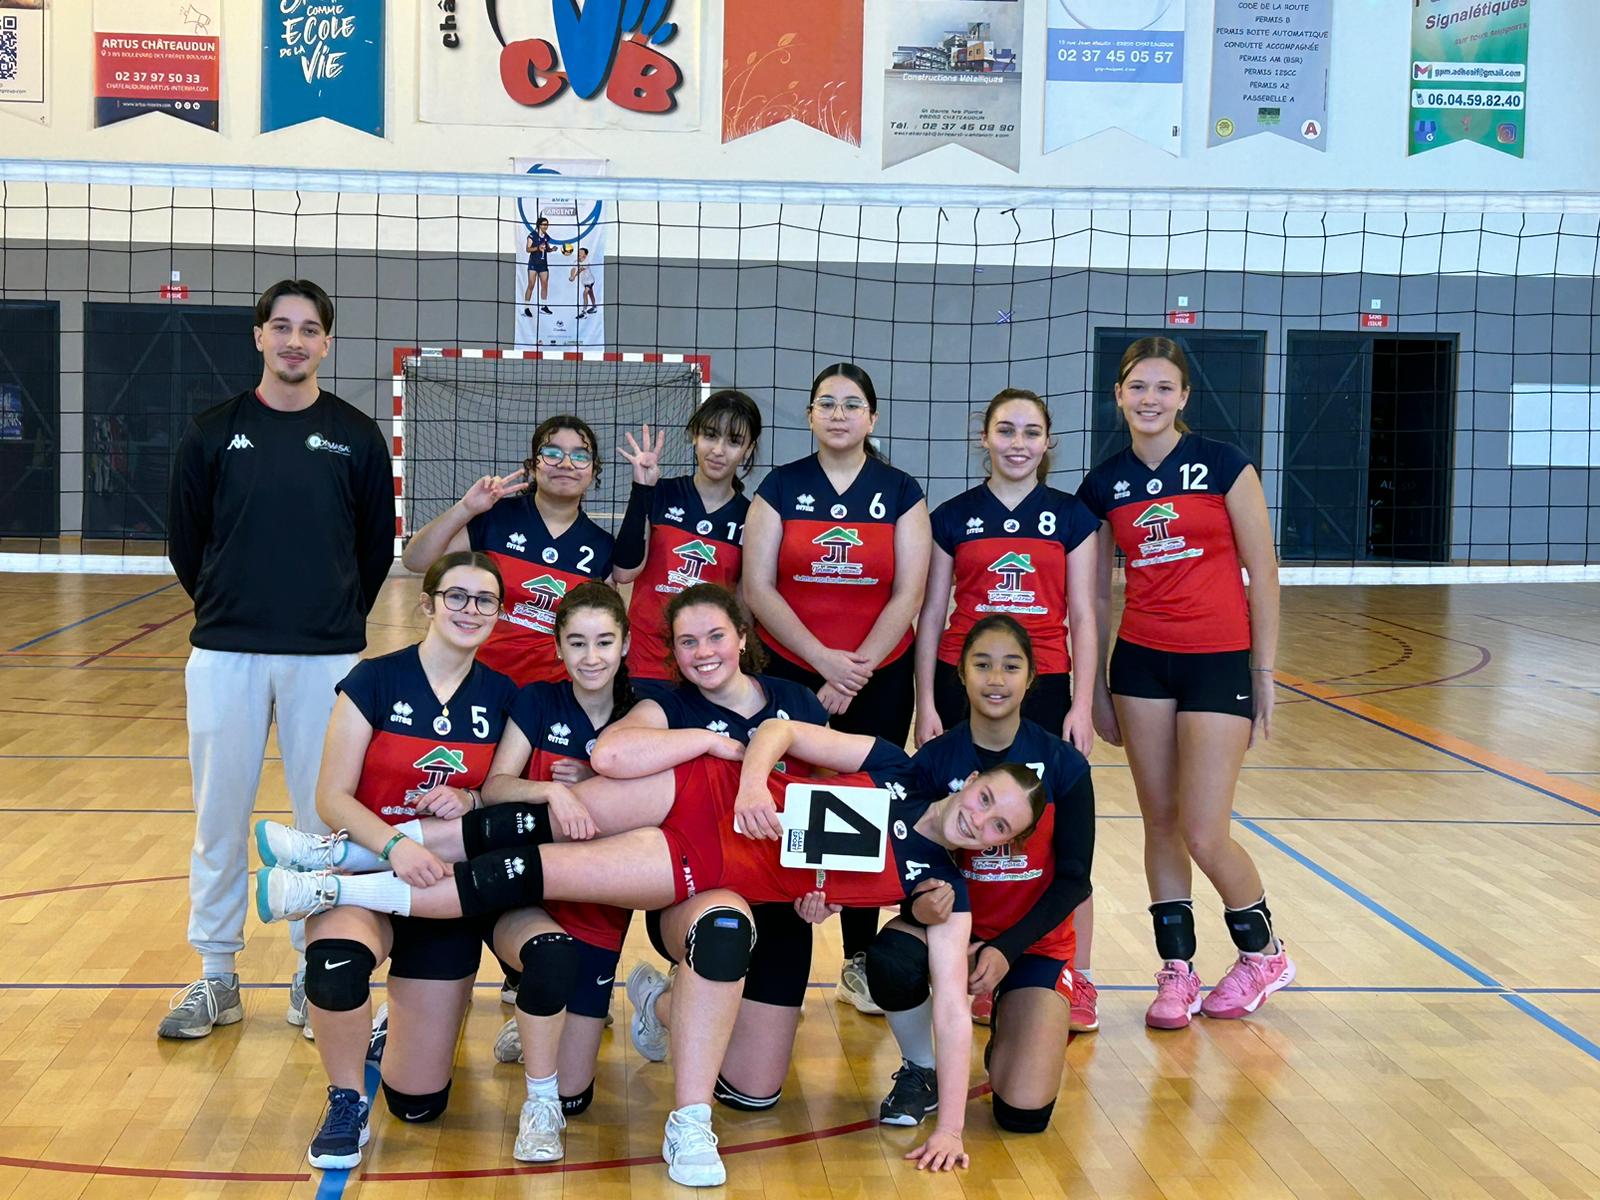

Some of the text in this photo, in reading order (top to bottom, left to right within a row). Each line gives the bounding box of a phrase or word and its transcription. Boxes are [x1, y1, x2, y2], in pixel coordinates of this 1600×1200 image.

[1238, 2, 1258, 10] CODE
[1260, 2, 1270, 10] DE
[1272, 3, 1282, 11] LA
[1255, 15, 1283, 24] PERMIS
[1425, 0, 1529, 30] Signalétiques
[1216, 27, 1244, 36] PERMIS
[1272, 29, 1329, 40] AUTOMATIQUE
[102, 38, 216, 52] ARTUS CHÂTEAUDUN
[1223, 41, 1320, 52] CONDUITE ACCOMPAGNÉE
[1058, 49, 1174, 64] 02 37 45 05 57
[1239, 54, 1267, 63] PERMIS
[1268, 55, 1281, 63] AM
[115, 71, 201, 84] 02 37 97 50 33
[902, 72, 957, 82] Constructions
[1244, 68, 1272, 77] PERMIS
[1249, 81, 1290, 90] PERMIS A2
[1242, 94, 1296, 103] PASSERELLE A
[1428, 92, 1521, 108] 06.04.59.82.40
[922, 122, 937, 130] 02
[1179, 463, 1209, 490] 12
[869, 492, 887, 520] 6
[1038, 511, 1057, 536] 8
[576, 545, 595, 574] 2
[470, 705, 490, 739] 5
[805, 789, 882, 865] 4
[905, 859, 931, 881] 4
